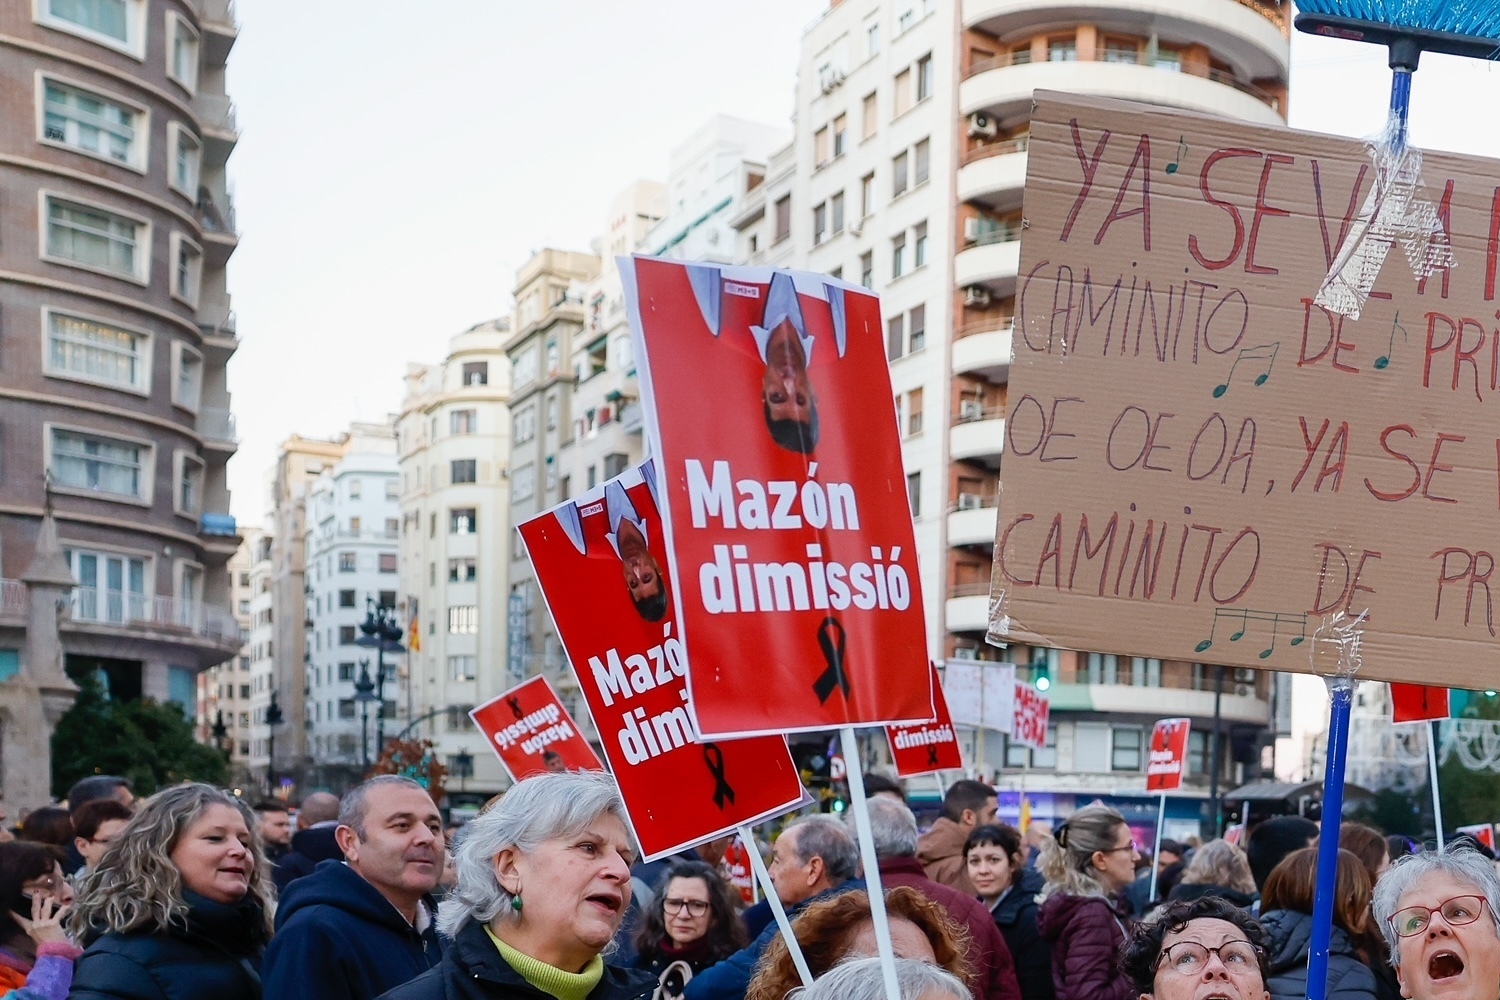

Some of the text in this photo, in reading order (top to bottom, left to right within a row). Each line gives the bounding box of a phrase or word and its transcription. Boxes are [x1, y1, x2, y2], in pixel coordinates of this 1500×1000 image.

[1059, 119, 1150, 251] YA
[1189, 148, 1294, 274] SE
[1418, 179, 1454, 299] A
[1021, 261, 1249, 364] CAMINITO
[1298, 297, 1360, 373] DE
[1009, 394, 1084, 462] OE
[1106, 405, 1175, 472] OE
[1291, 416, 1348, 493] YA
[1364, 424, 1466, 503] SE
[684, 459, 860, 530] Mazón
[699, 544, 911, 614] dimissió
[1000, 503, 1260, 605] CAMINITO
[1306, 542, 1382, 621] DE
[494, 703, 560, 750] dimissió
[521, 720, 574, 756] Mazón
[894, 723, 954, 750] dimissió
